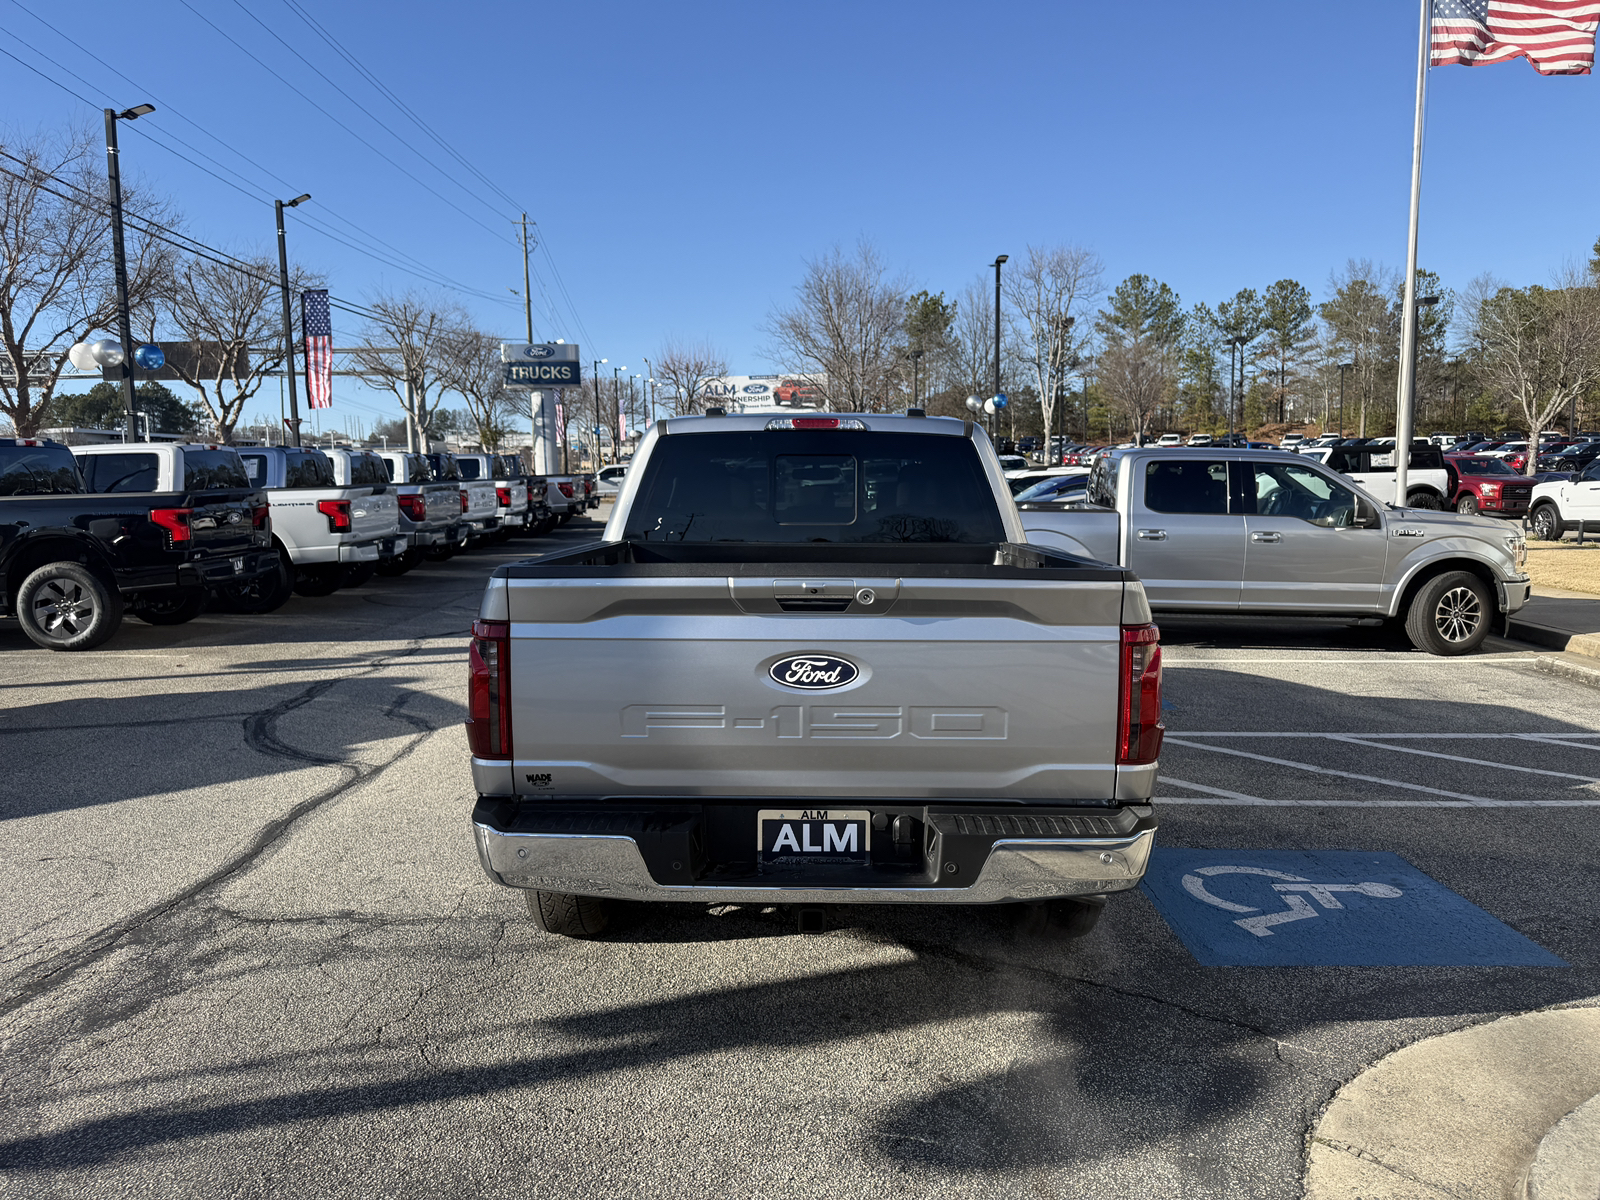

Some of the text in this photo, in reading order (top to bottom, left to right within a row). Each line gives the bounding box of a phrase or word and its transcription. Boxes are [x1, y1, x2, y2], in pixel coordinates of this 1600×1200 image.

[510, 366, 572, 379] TRUCKS
[703, 384, 736, 396] ALM
[785, 659, 842, 683] Ford
[620, 704, 1008, 740] F-150
[525, 773, 552, 783] WADE
[801, 810, 828, 820] ALM
[772, 823, 858, 852] ALM
